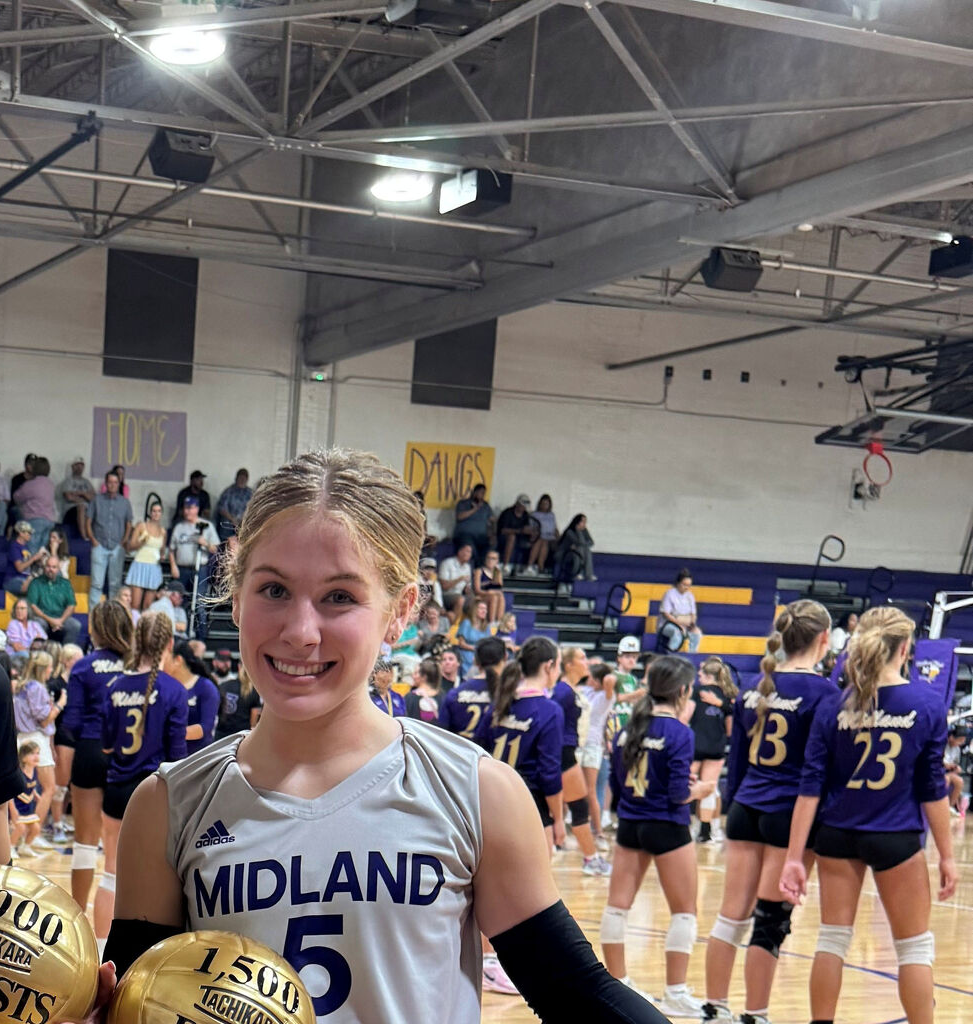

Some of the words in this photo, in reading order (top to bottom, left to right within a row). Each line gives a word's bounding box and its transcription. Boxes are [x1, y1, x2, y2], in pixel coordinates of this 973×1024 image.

[107, 412, 181, 472] HOME
[409, 448, 486, 502] DAWGS
[121, 708, 143, 755] 3
[846, 731, 902, 790] 23
[195, 833, 236, 849] adidas
[193, 851, 445, 918] MIDLAND
[193, 948, 300, 1014] 1,500
[282, 914, 352, 1017] 5
